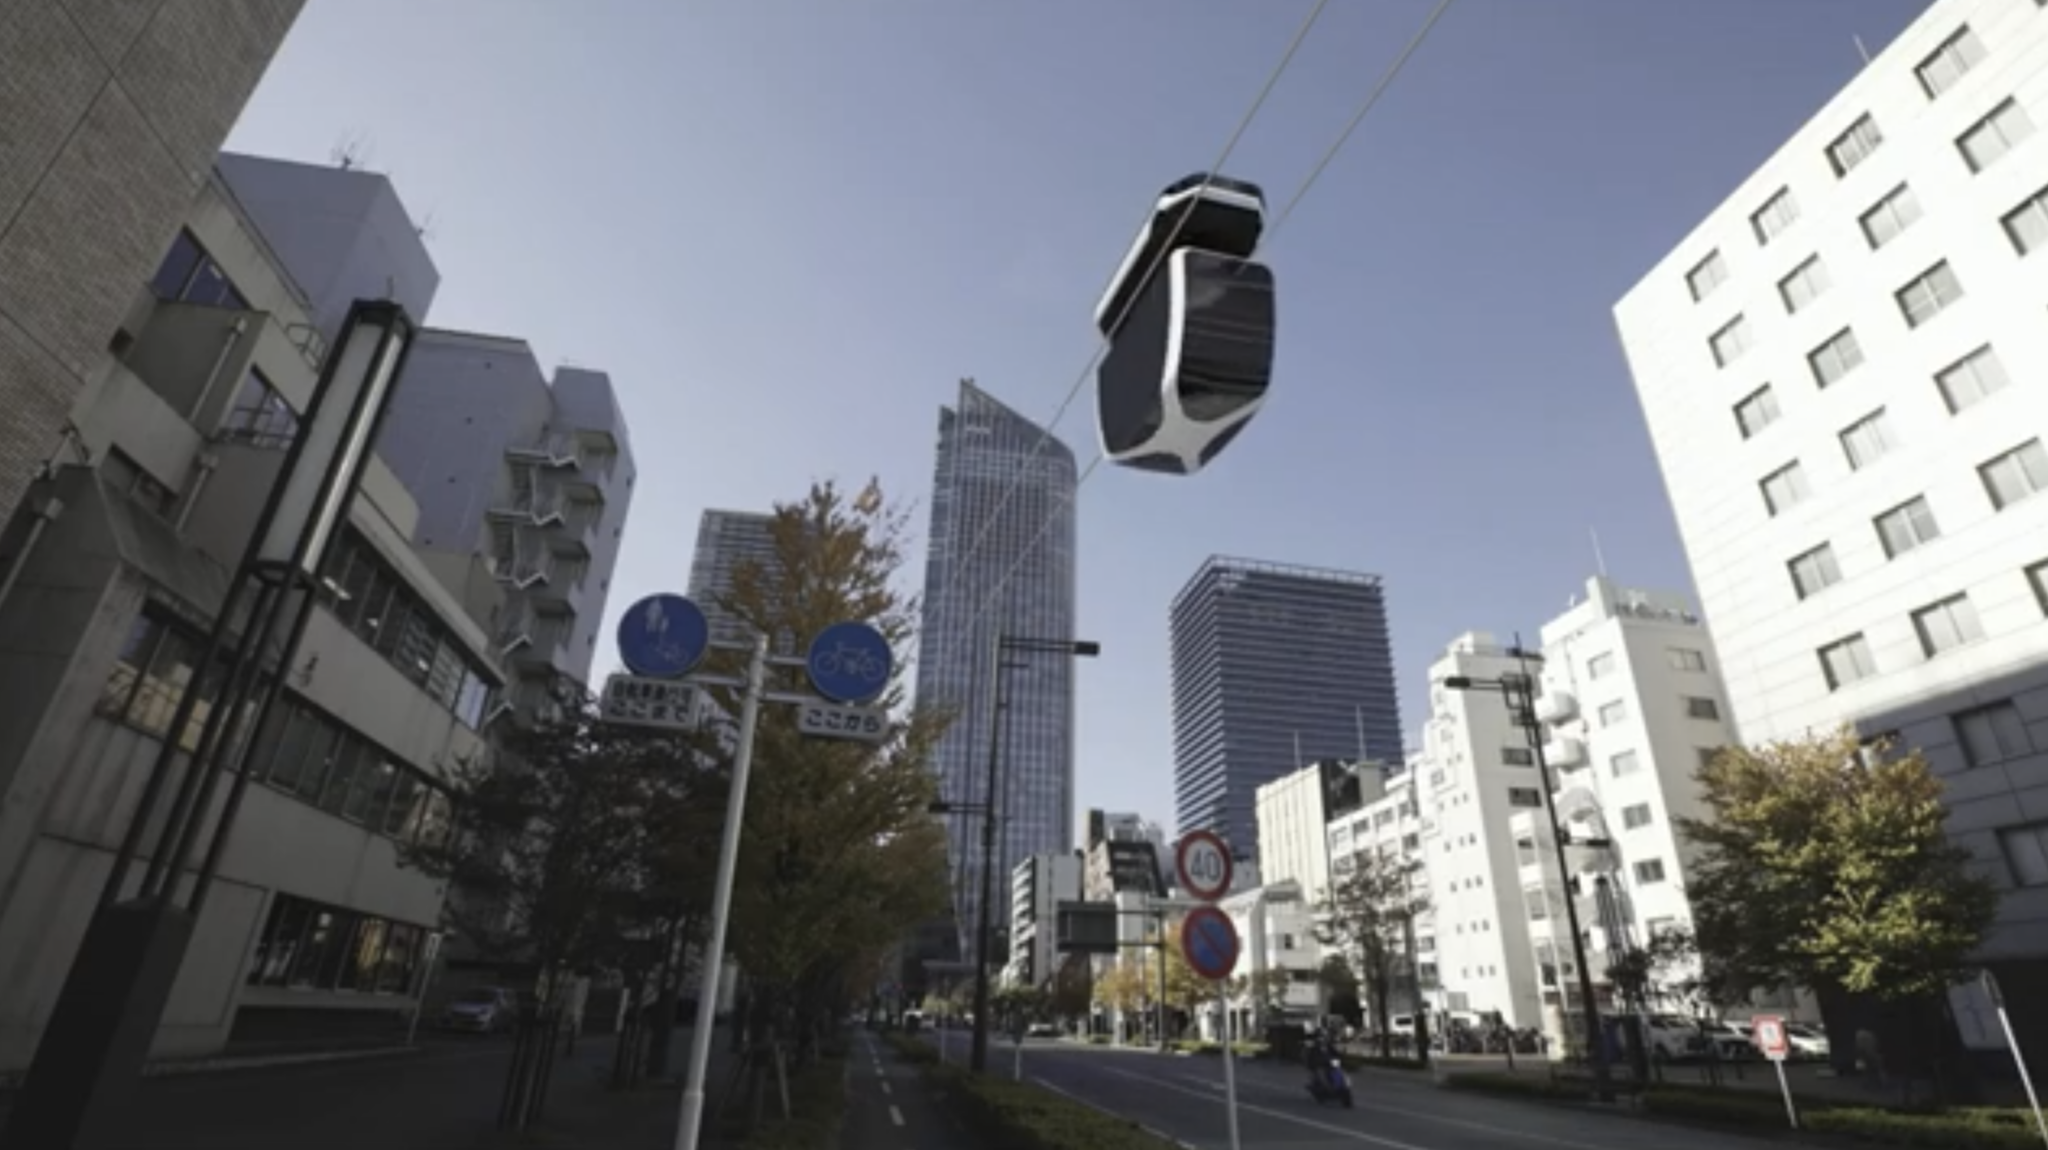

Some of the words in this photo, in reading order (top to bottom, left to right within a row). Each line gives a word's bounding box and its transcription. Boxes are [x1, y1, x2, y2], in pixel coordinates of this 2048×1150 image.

[609, 701, 689, 723] ここまで
[805, 708, 880, 733] ここから
[1191, 849, 1220, 882] 40
